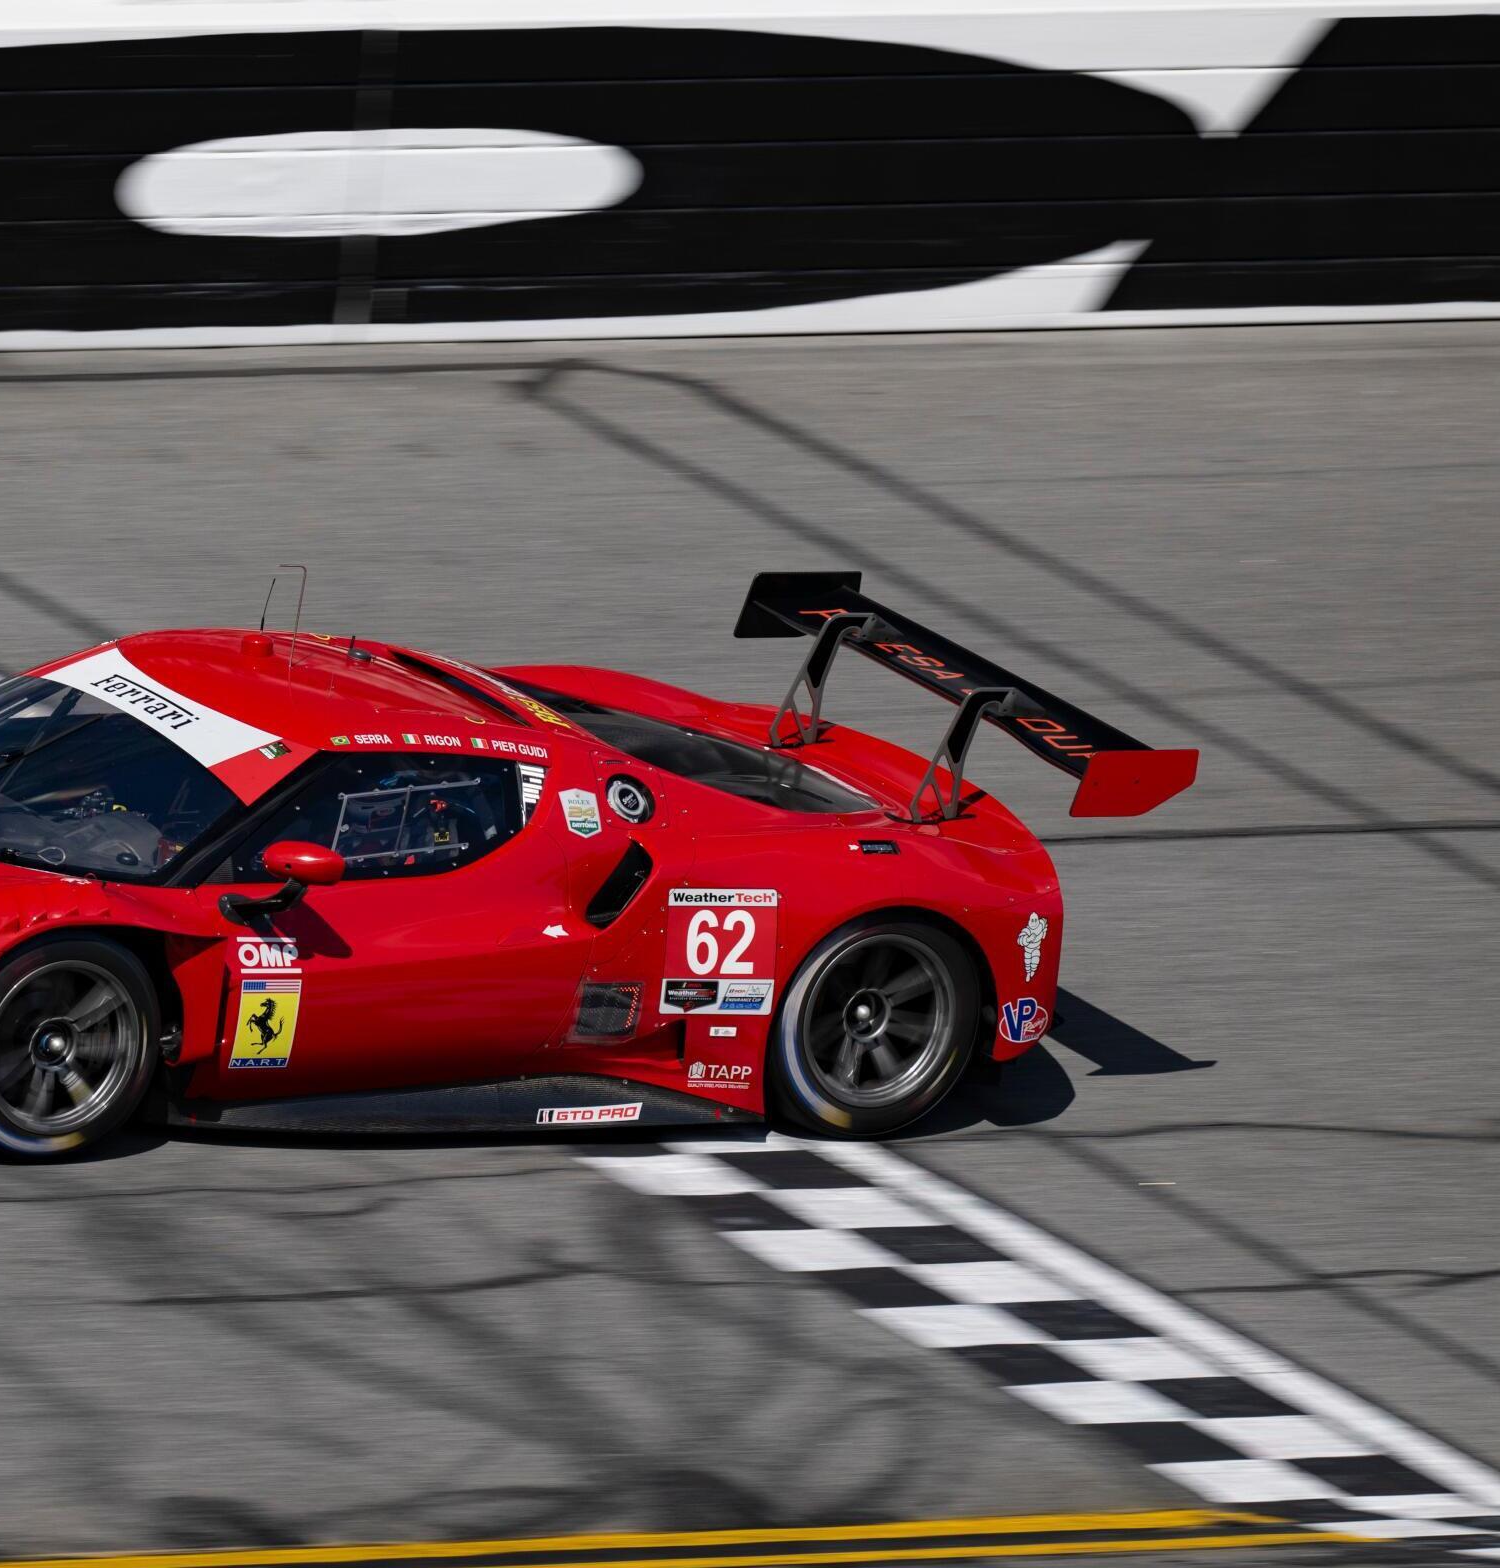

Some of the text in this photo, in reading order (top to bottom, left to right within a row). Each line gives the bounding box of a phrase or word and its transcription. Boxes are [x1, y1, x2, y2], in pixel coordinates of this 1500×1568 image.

[90, 674, 200, 730] Ferrari
[353, 734, 393, 745] SERRA
[424, 734, 462, 747] RIGON
[491, 739, 548, 759] PIER GUIDI
[568, 806, 596, 818] 24
[686, 909, 756, 975] 62
[237, 943, 299, 968] OMP
[1002, 997, 1038, 1041] VP
[230, 1058, 286, 1067] N.A.R.T.
[708, 1064, 752, 1080] TAPP
[556, 1106, 638, 1121] GTD PRO
